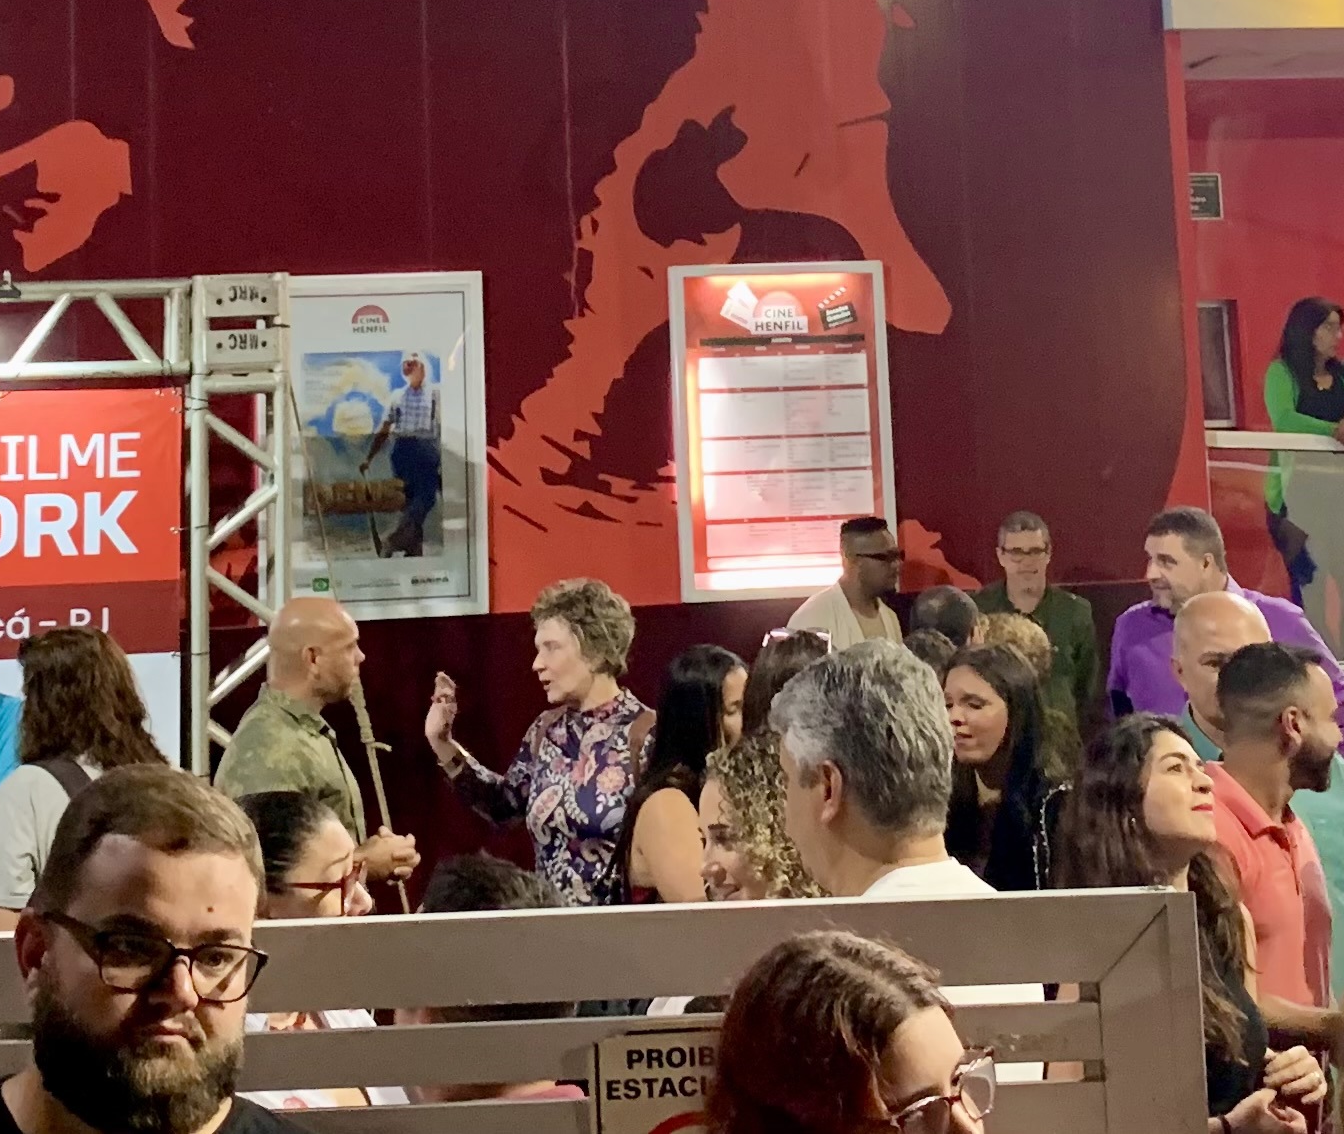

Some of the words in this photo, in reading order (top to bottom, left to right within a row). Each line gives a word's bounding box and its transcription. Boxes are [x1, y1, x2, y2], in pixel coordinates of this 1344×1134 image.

[764, 308, 794, 319] CINE
[755, 319, 805, 332] HENFIL
[626, 1047, 716, 1070] PROIB
[605, 1076, 707, 1101] ESTACI
